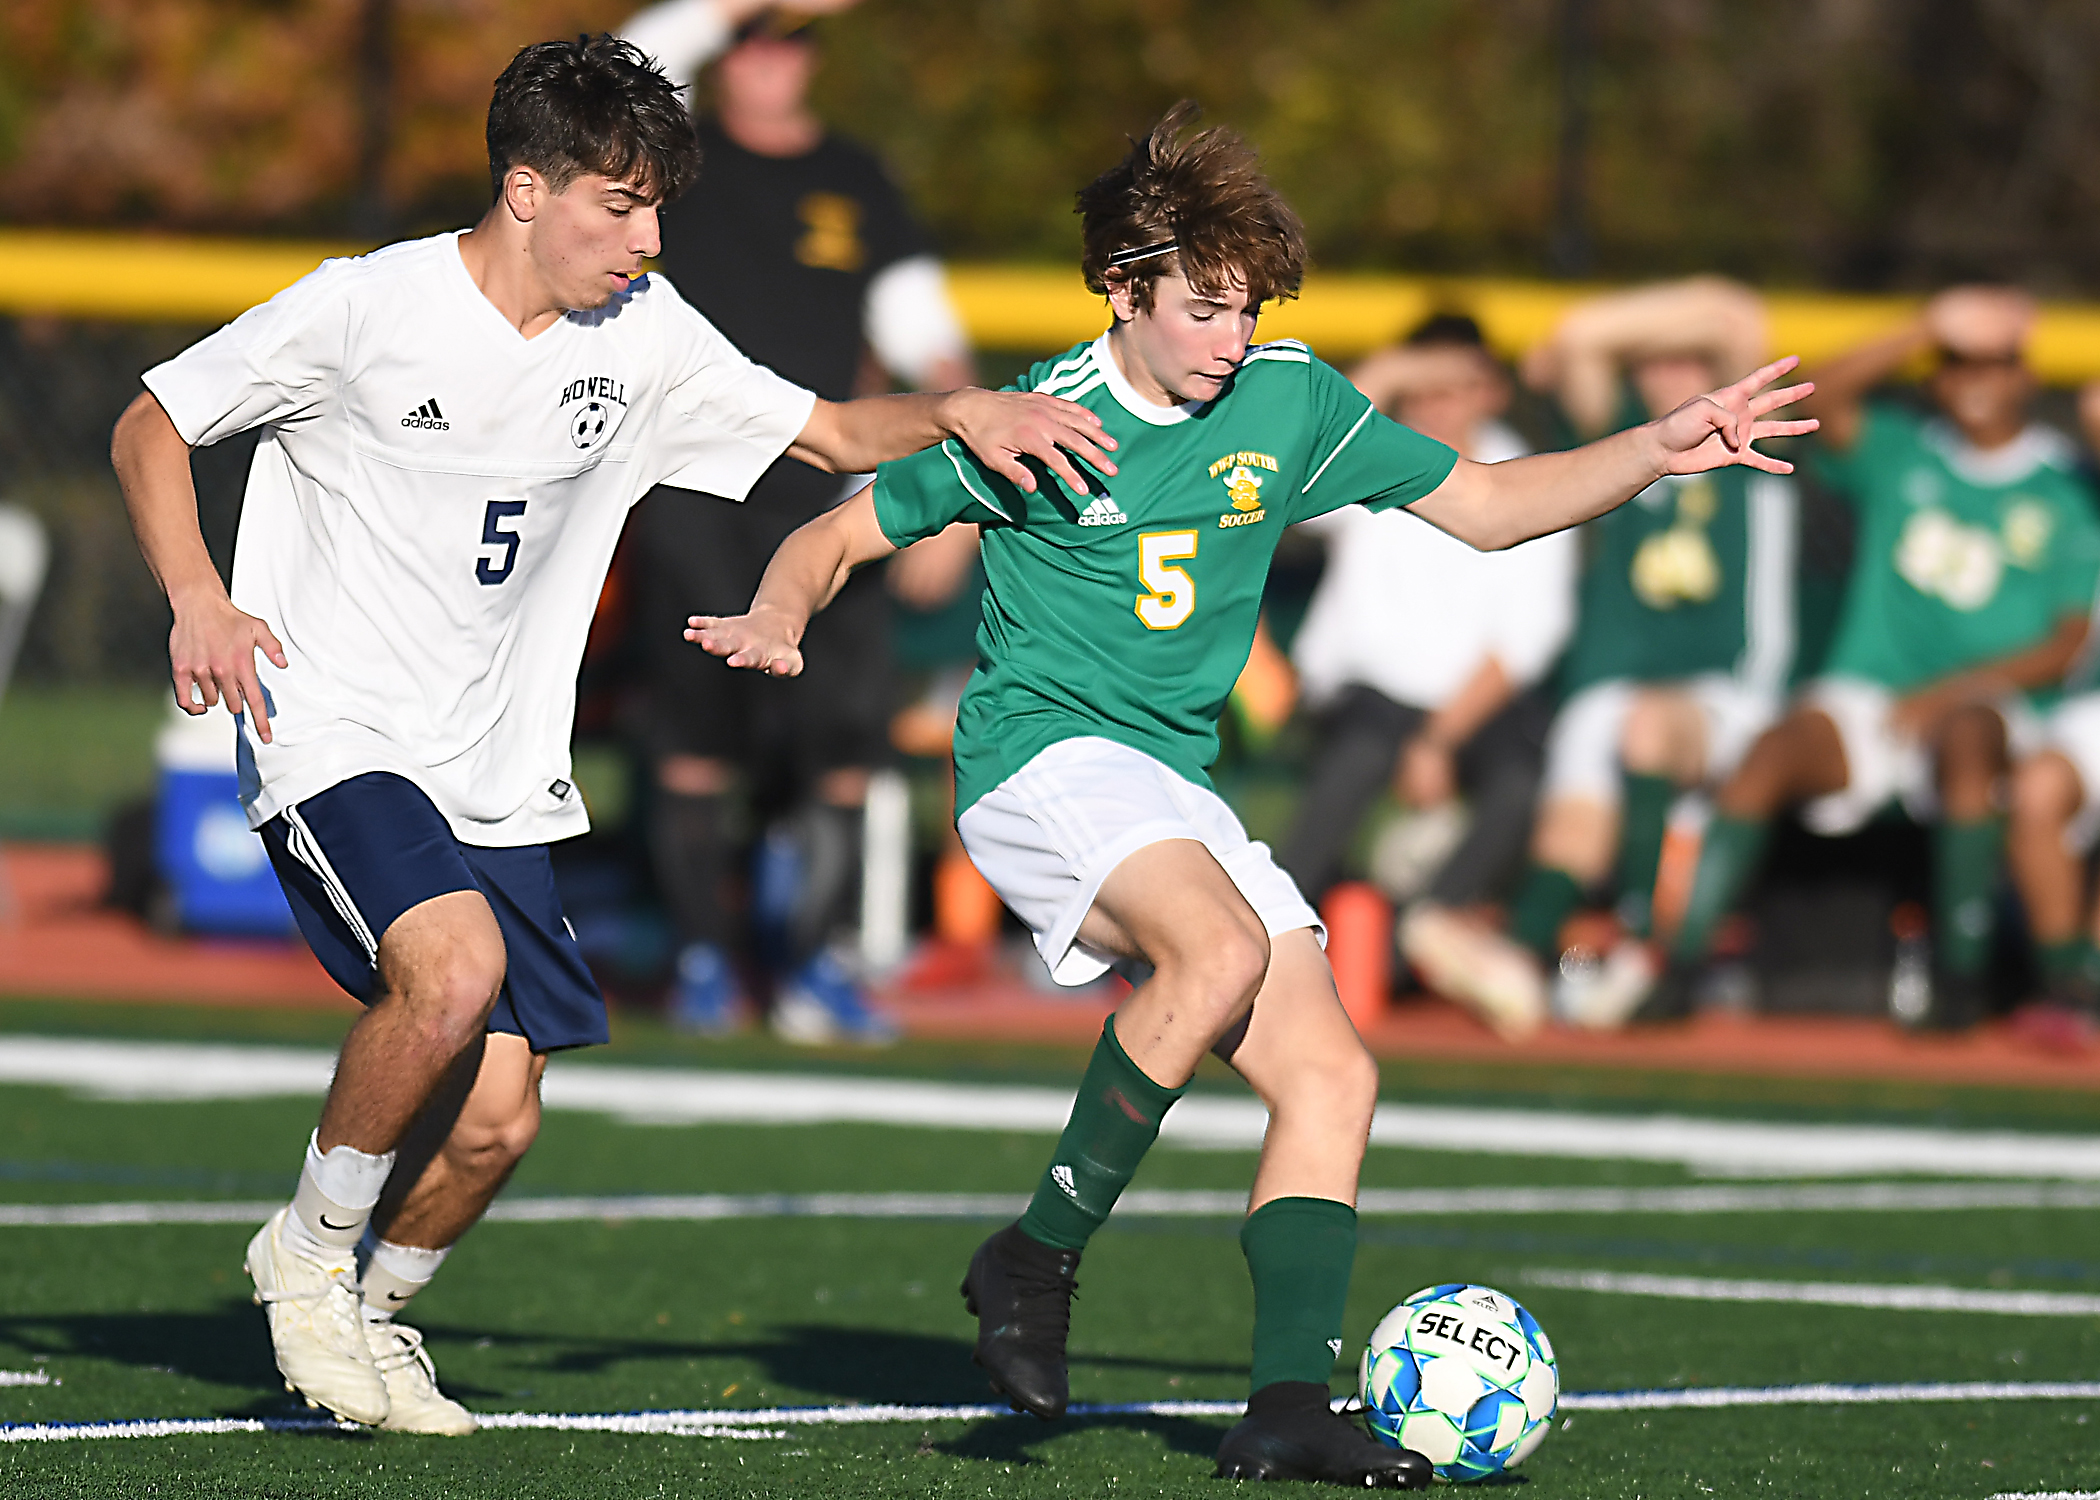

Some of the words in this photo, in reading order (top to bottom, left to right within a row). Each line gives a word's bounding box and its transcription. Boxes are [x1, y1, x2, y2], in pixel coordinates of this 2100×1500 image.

[401, 417, 450, 431] adidas
[1236, 451, 1279, 473] SOUTH
[1077, 512, 1128, 527] adidas
[1218, 509, 1266, 529] SOCCER
[475, 499, 528, 585] 5
[1134, 529, 1199, 630] 5
[1472, 1299, 1499, 1313] SELECT
[1416, 1312, 1521, 1371] SELECT
